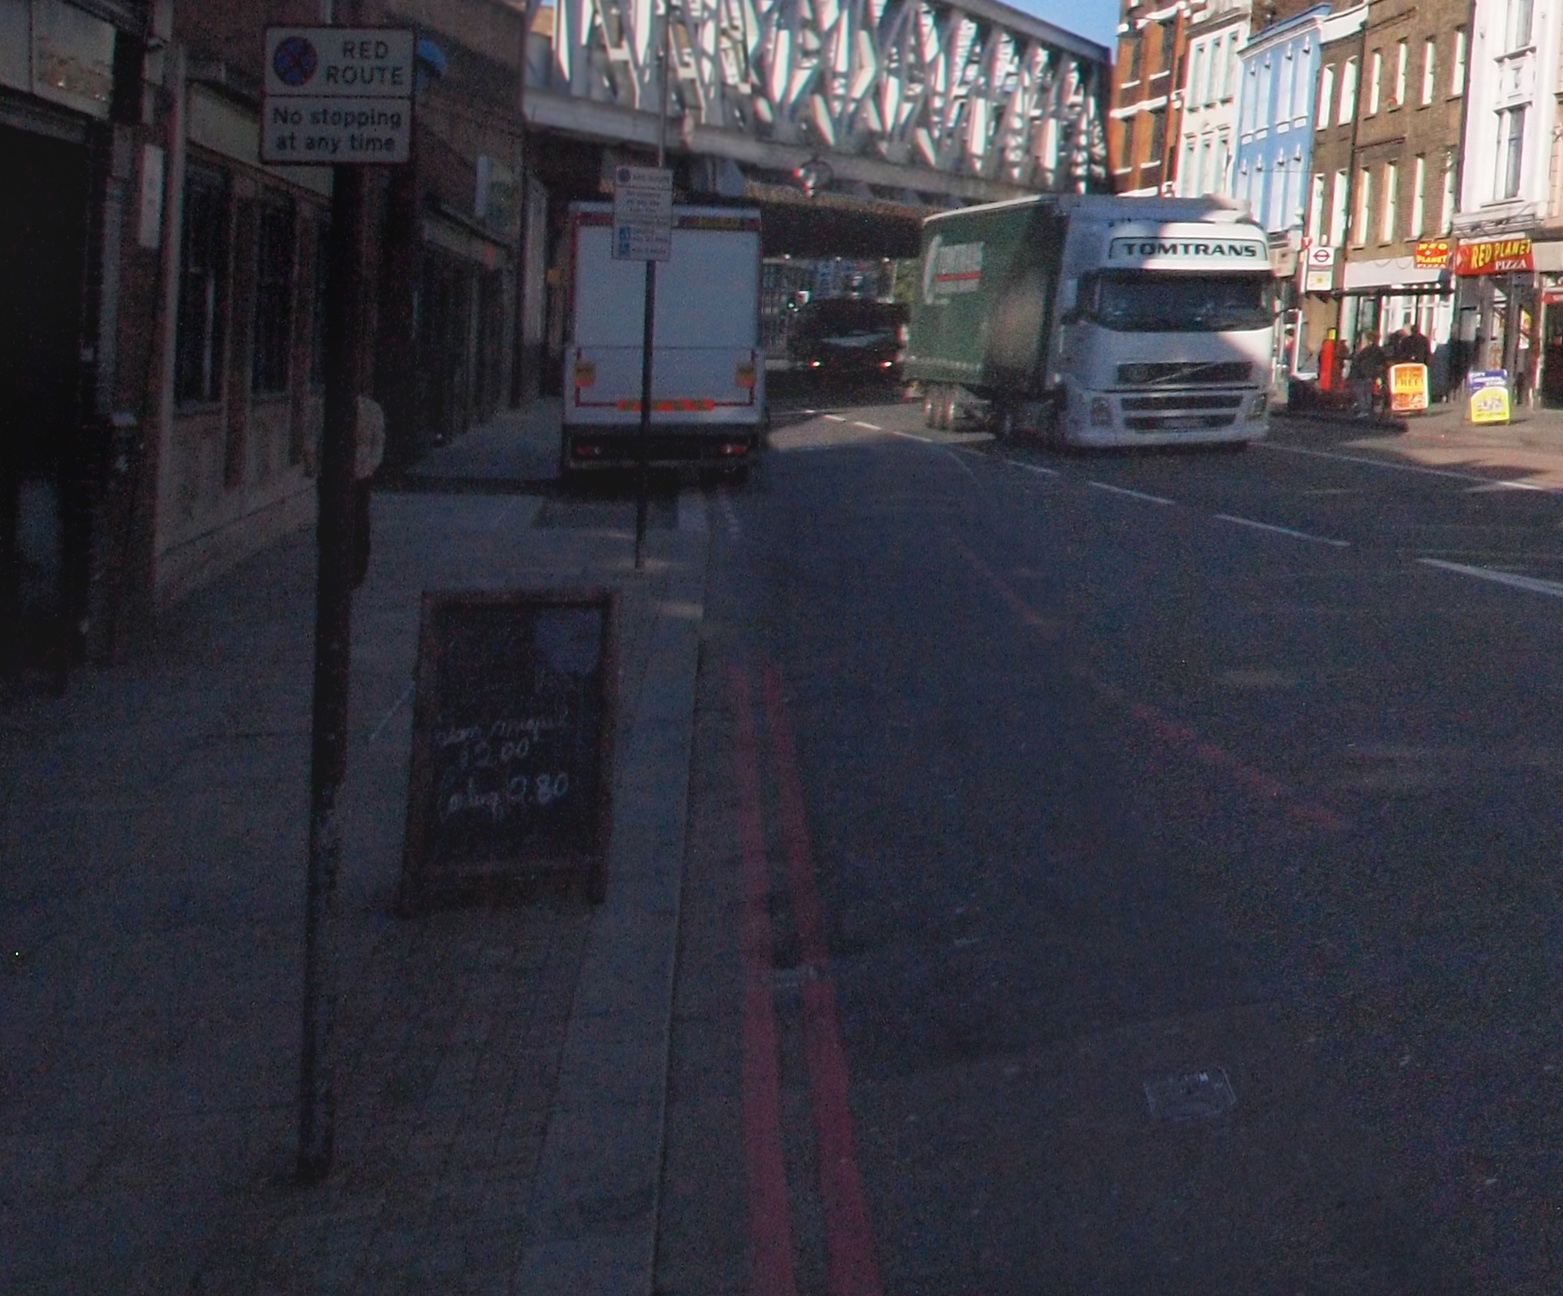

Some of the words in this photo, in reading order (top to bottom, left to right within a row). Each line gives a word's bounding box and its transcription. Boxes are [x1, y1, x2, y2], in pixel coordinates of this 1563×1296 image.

[343, 40, 388, 60] RED
[325, 65, 404, 85] ROUTE
[272, 106, 302, 125] No
[309, 107, 402, 129] stopping
[275, 131, 297, 151] at
[304, 135, 340, 154] any
[349, 131, 396, 152] time
[1123, 242, 1257, 258] TOMTRANS
[1416, 255, 1447, 263] PLANET
[1471, 244, 1493, 269] RED
[1494, 239, 1532, 257] PLANET
[1495, 258, 1526, 270] PIZZA
